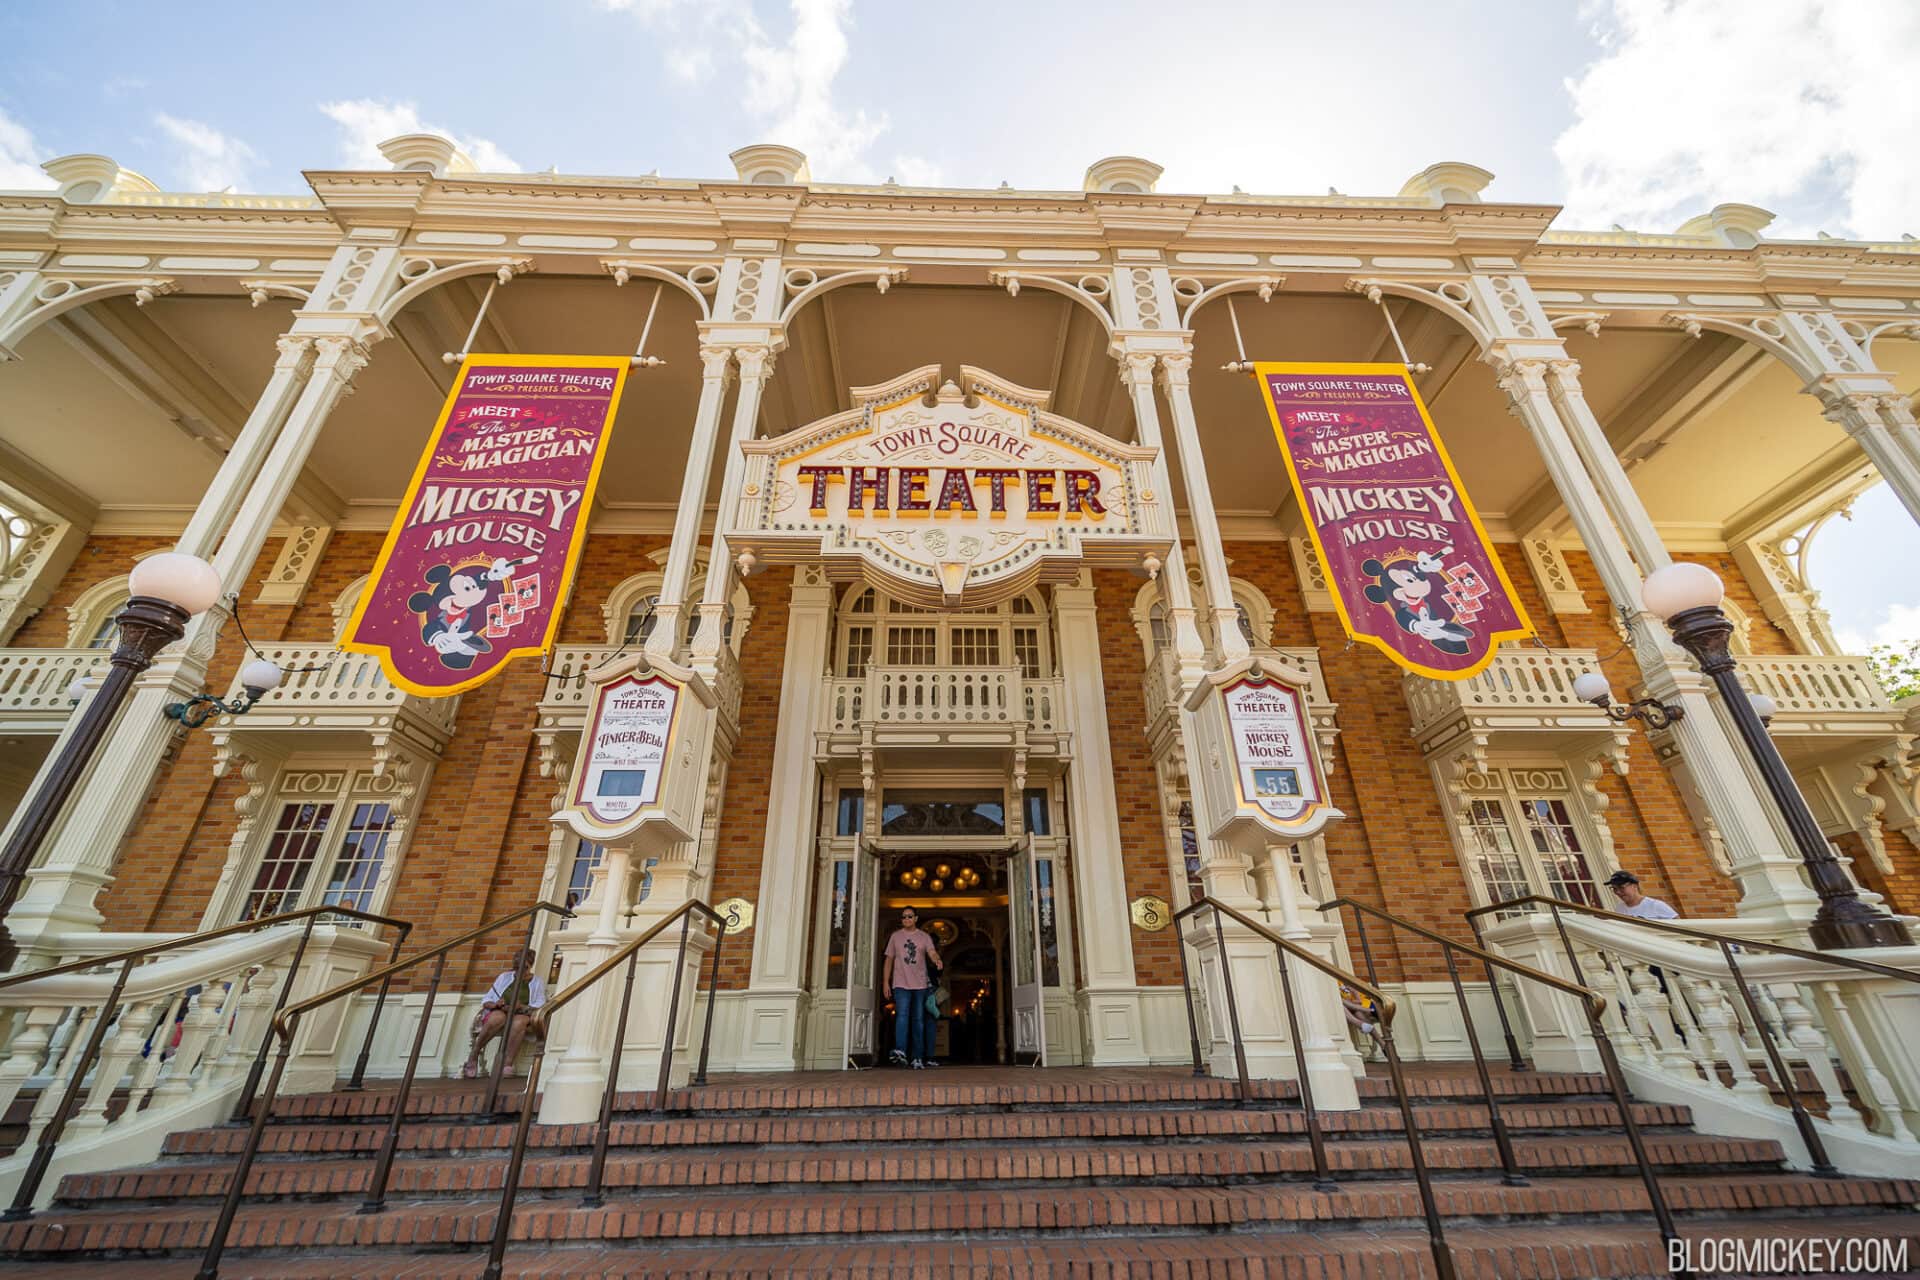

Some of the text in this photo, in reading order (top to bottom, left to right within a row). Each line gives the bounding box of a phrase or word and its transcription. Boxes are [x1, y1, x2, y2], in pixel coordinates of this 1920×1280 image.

[468, 373, 613, 390] TOWN SQUARE THEATER
[517, 385, 559, 393] PRESENTS
[1272, 381, 1408, 396] TOWN SQUARE THEATER
[468, 406, 520, 418] MEET
[1296, 411, 1341, 424] MEET
[477, 420, 506, 435] The
[1315, 425, 1340, 439] The
[459, 426, 558, 453] MASTER
[870, 422, 1034, 460] TOWN SQUARE
[1311, 430, 1389, 456] MASTER
[461, 437, 596, 472] MAGICIAN
[1324, 439, 1432, 473] MAGICIAN
[797, 466, 1107, 521] THEATER
[408, 485, 581, 532] MICKEY
[1309, 485, 1458, 528] MICKEY
[424, 521, 547, 553] MOUSE
[1342, 520, 1455, 548] MOUSE
[612, 699, 666, 709] THEATER
[1235, 703, 1287, 712] THEATER
[598, 731, 637, 748] TINKER
[1245, 733, 1289, 745] MICKEY
[1248, 745, 1293, 757] MOUSE
[1266, 776, 1291, 794] 55
